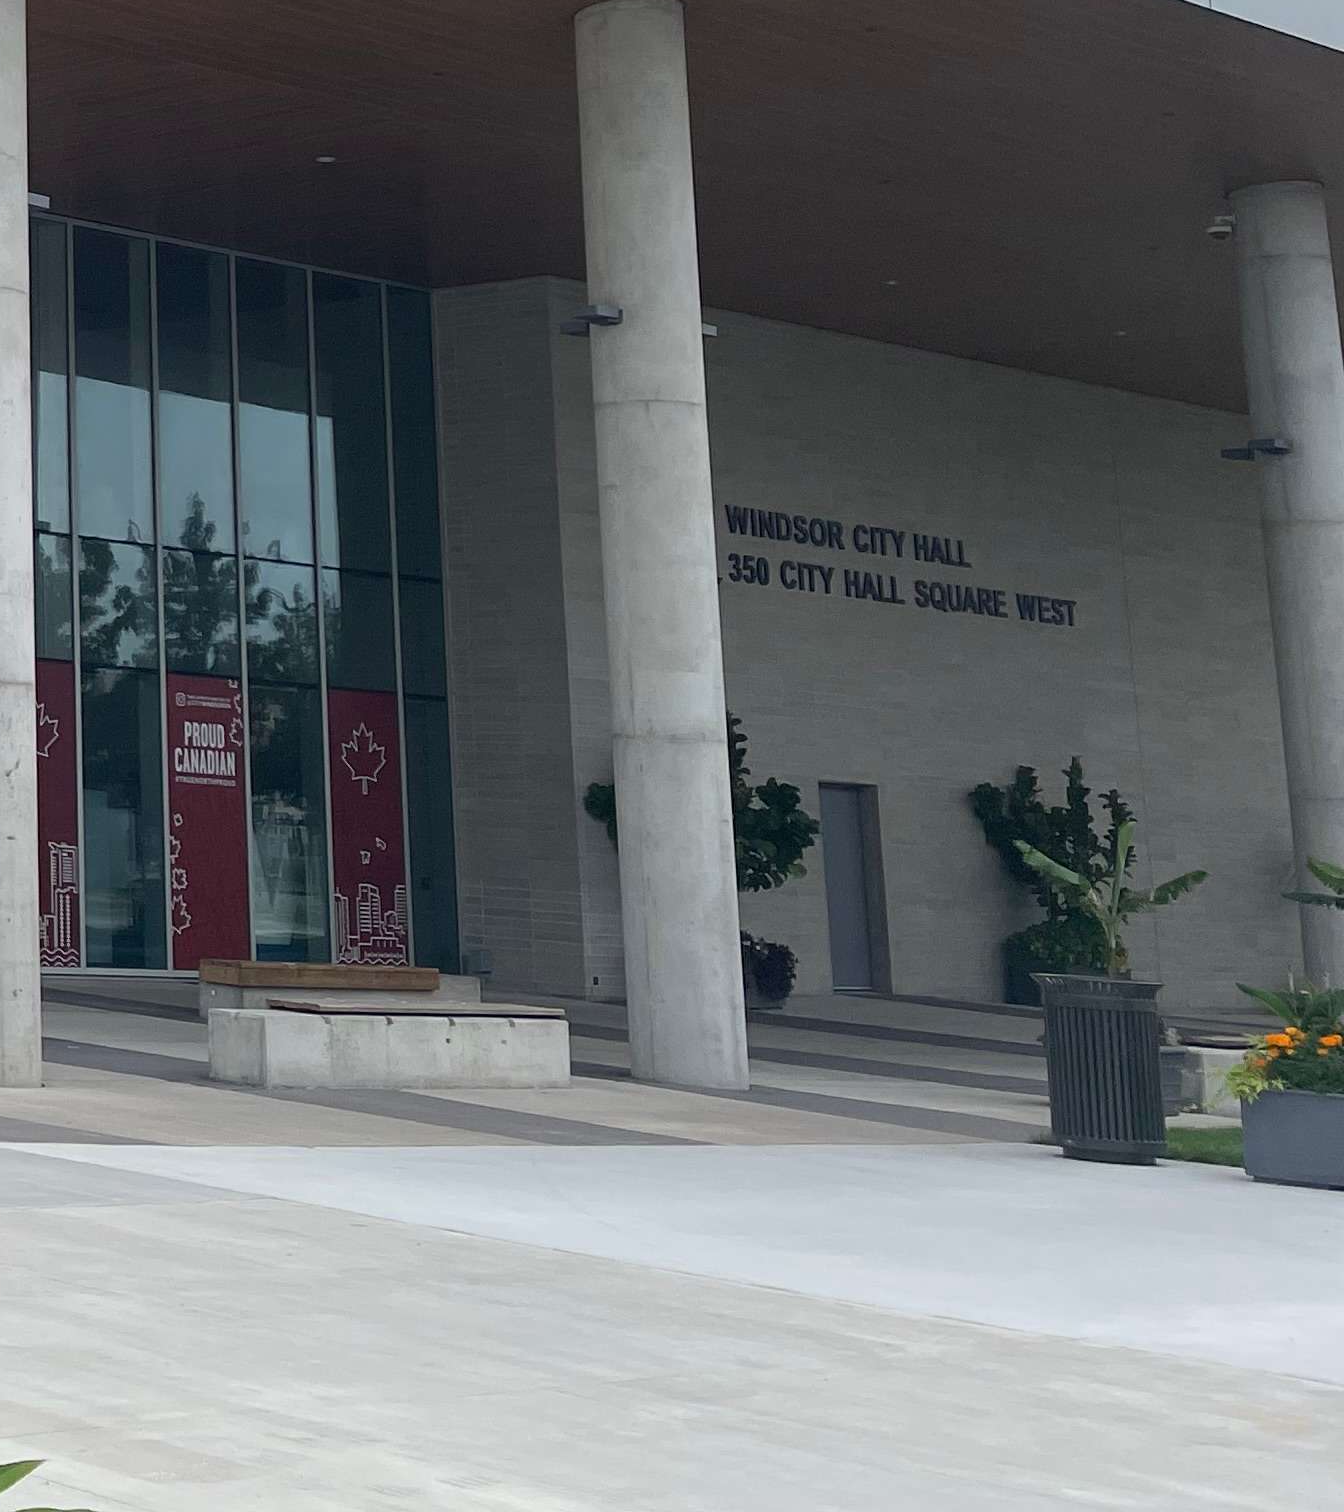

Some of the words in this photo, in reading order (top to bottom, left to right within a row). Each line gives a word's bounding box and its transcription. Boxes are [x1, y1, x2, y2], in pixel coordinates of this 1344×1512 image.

[724, 504, 845, 551] WINDSOR
[853, 524, 907, 558] CITY
[913, 533, 973, 569] HALL
[728, 553, 770, 586] 350
[780, 560, 835, 594] CITY
[844, 568, 906, 605] HALL
[914, 579, 1009, 619] SQUARE
[1015, 592, 1078, 627] WEST
[184, 720, 225, 749] PROUD
[174, 747, 236, 777] CANADIAN
